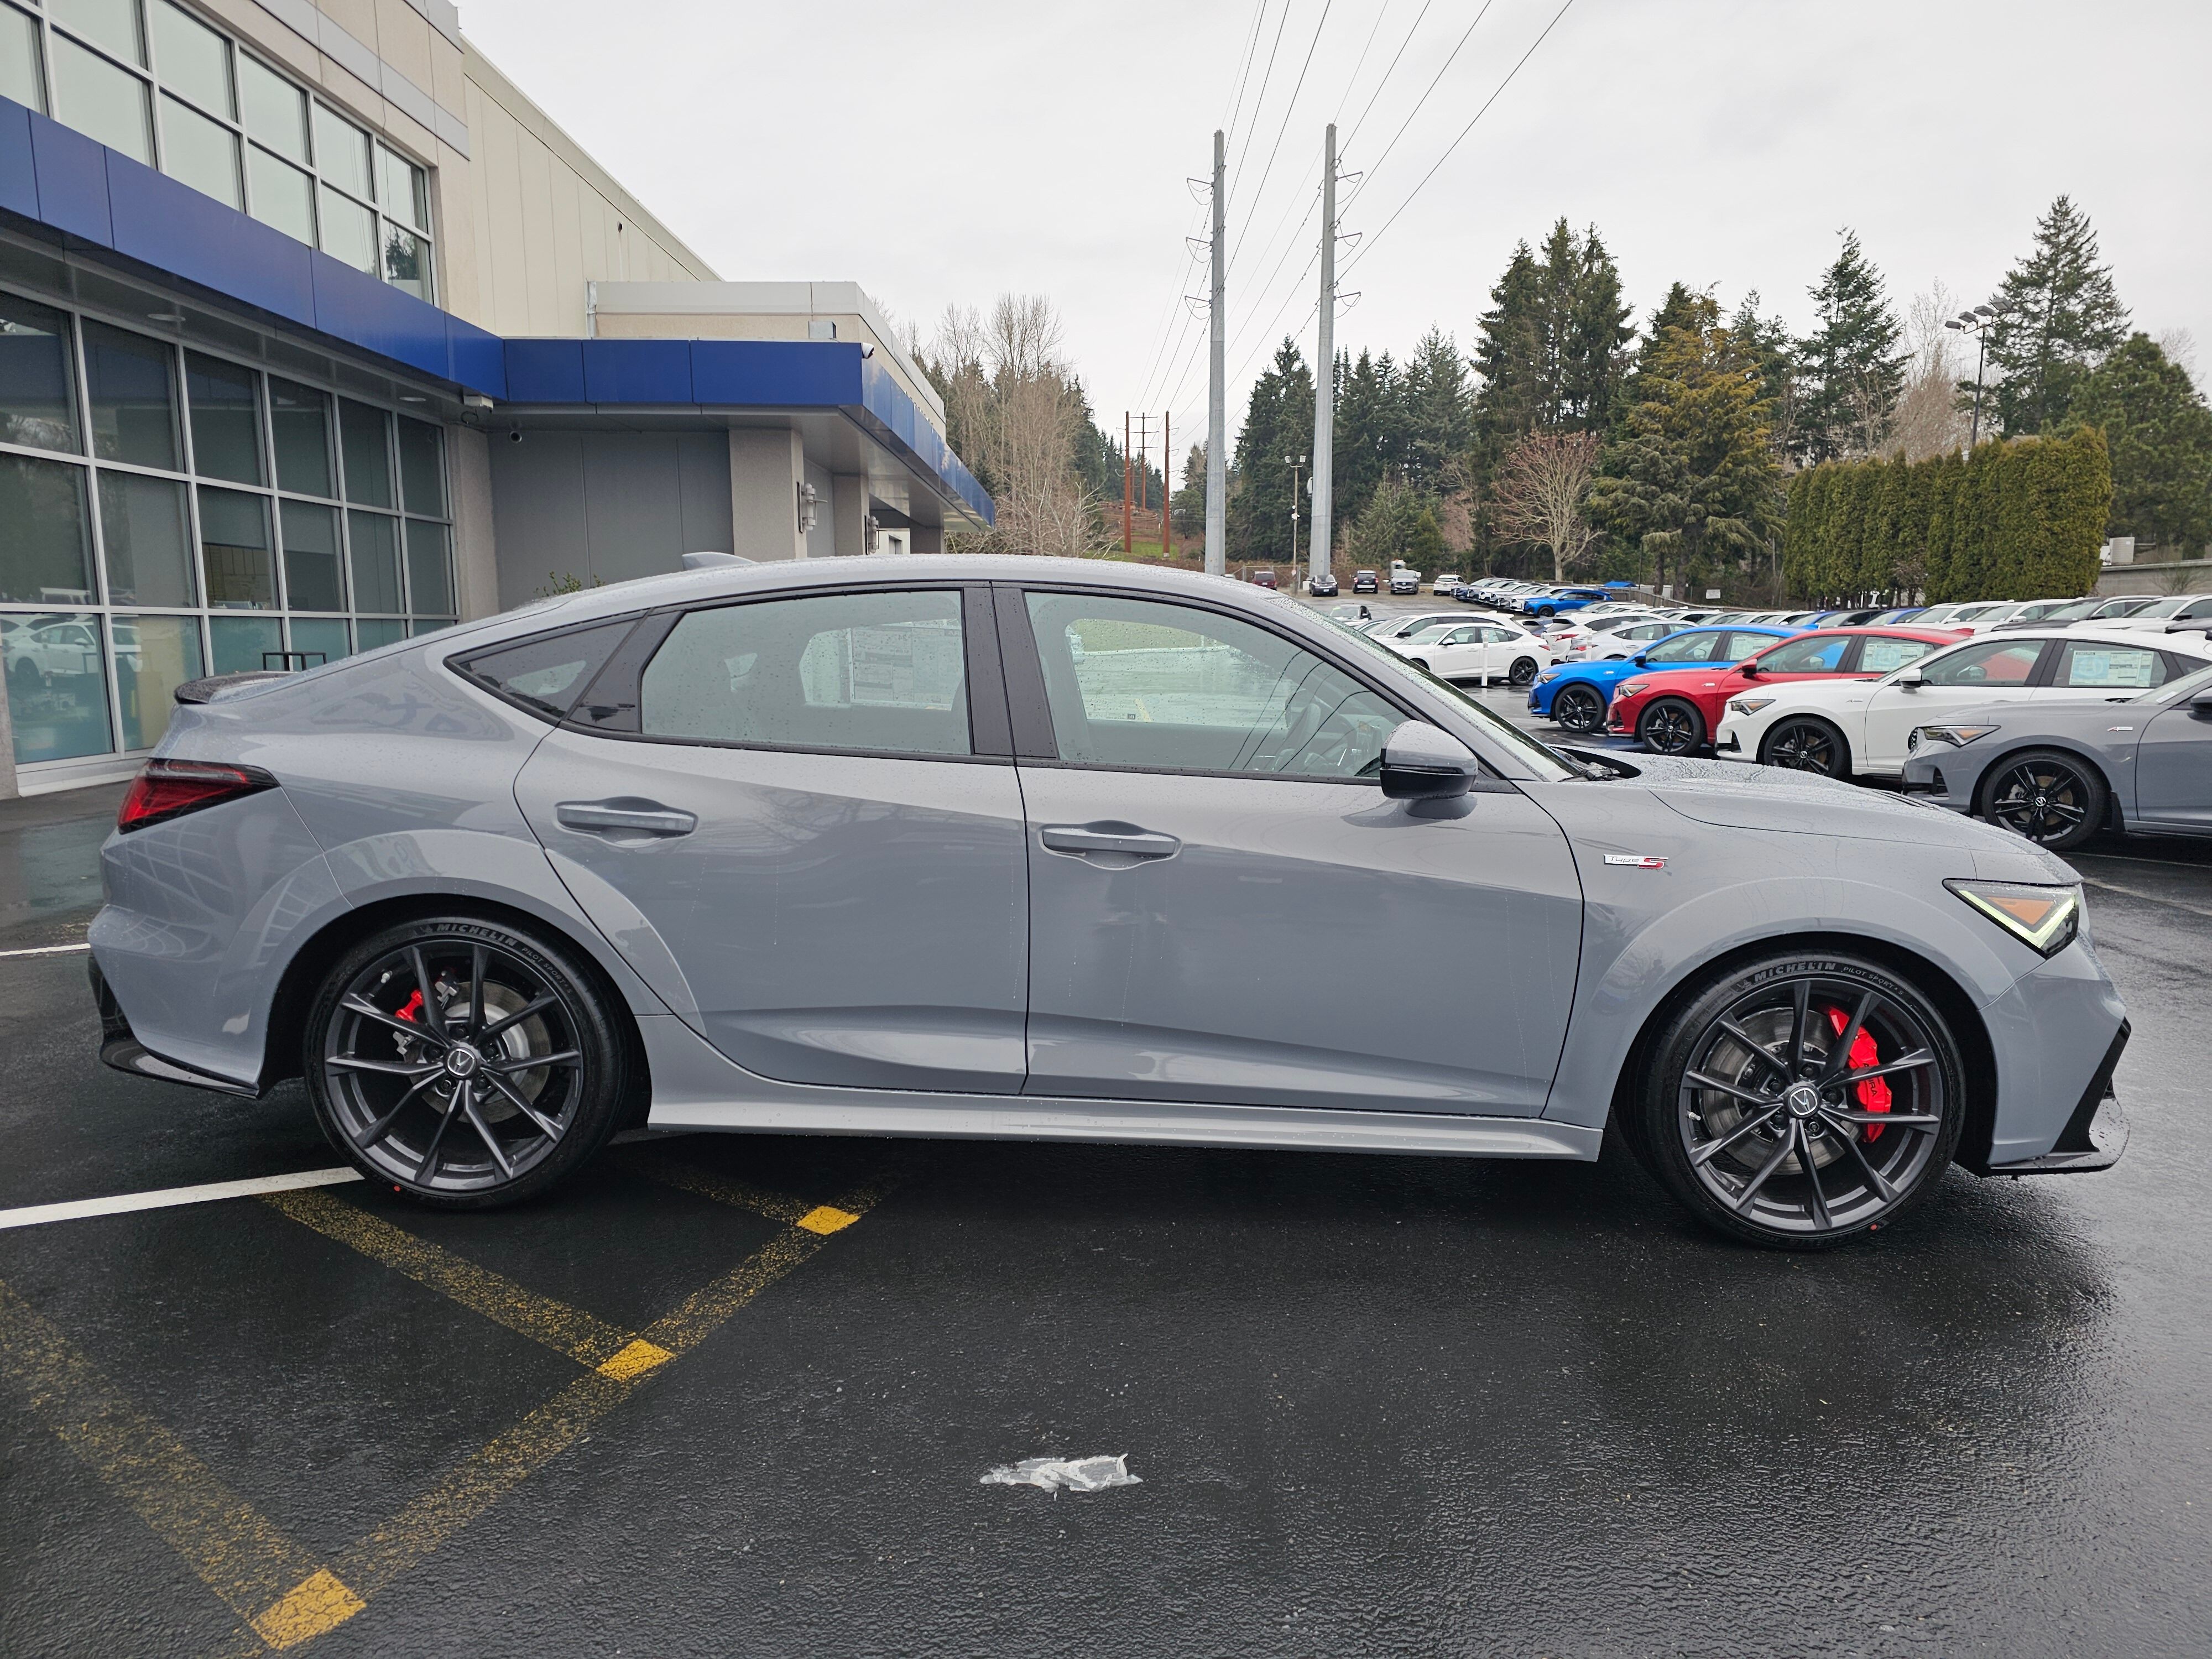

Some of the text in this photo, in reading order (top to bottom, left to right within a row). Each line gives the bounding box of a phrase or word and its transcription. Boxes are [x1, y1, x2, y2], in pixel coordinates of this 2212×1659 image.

[1637, 857, 1668, 869] S
[437, 924, 565, 983] MICHELIN PILOT SPORT
[1755, 962, 1836, 982] MICHELIN
[1843, 966, 1867, 975] PILOT
[1869, 974, 1894, 988] SPORT
[1863, 1063, 1878, 1096] ARA
